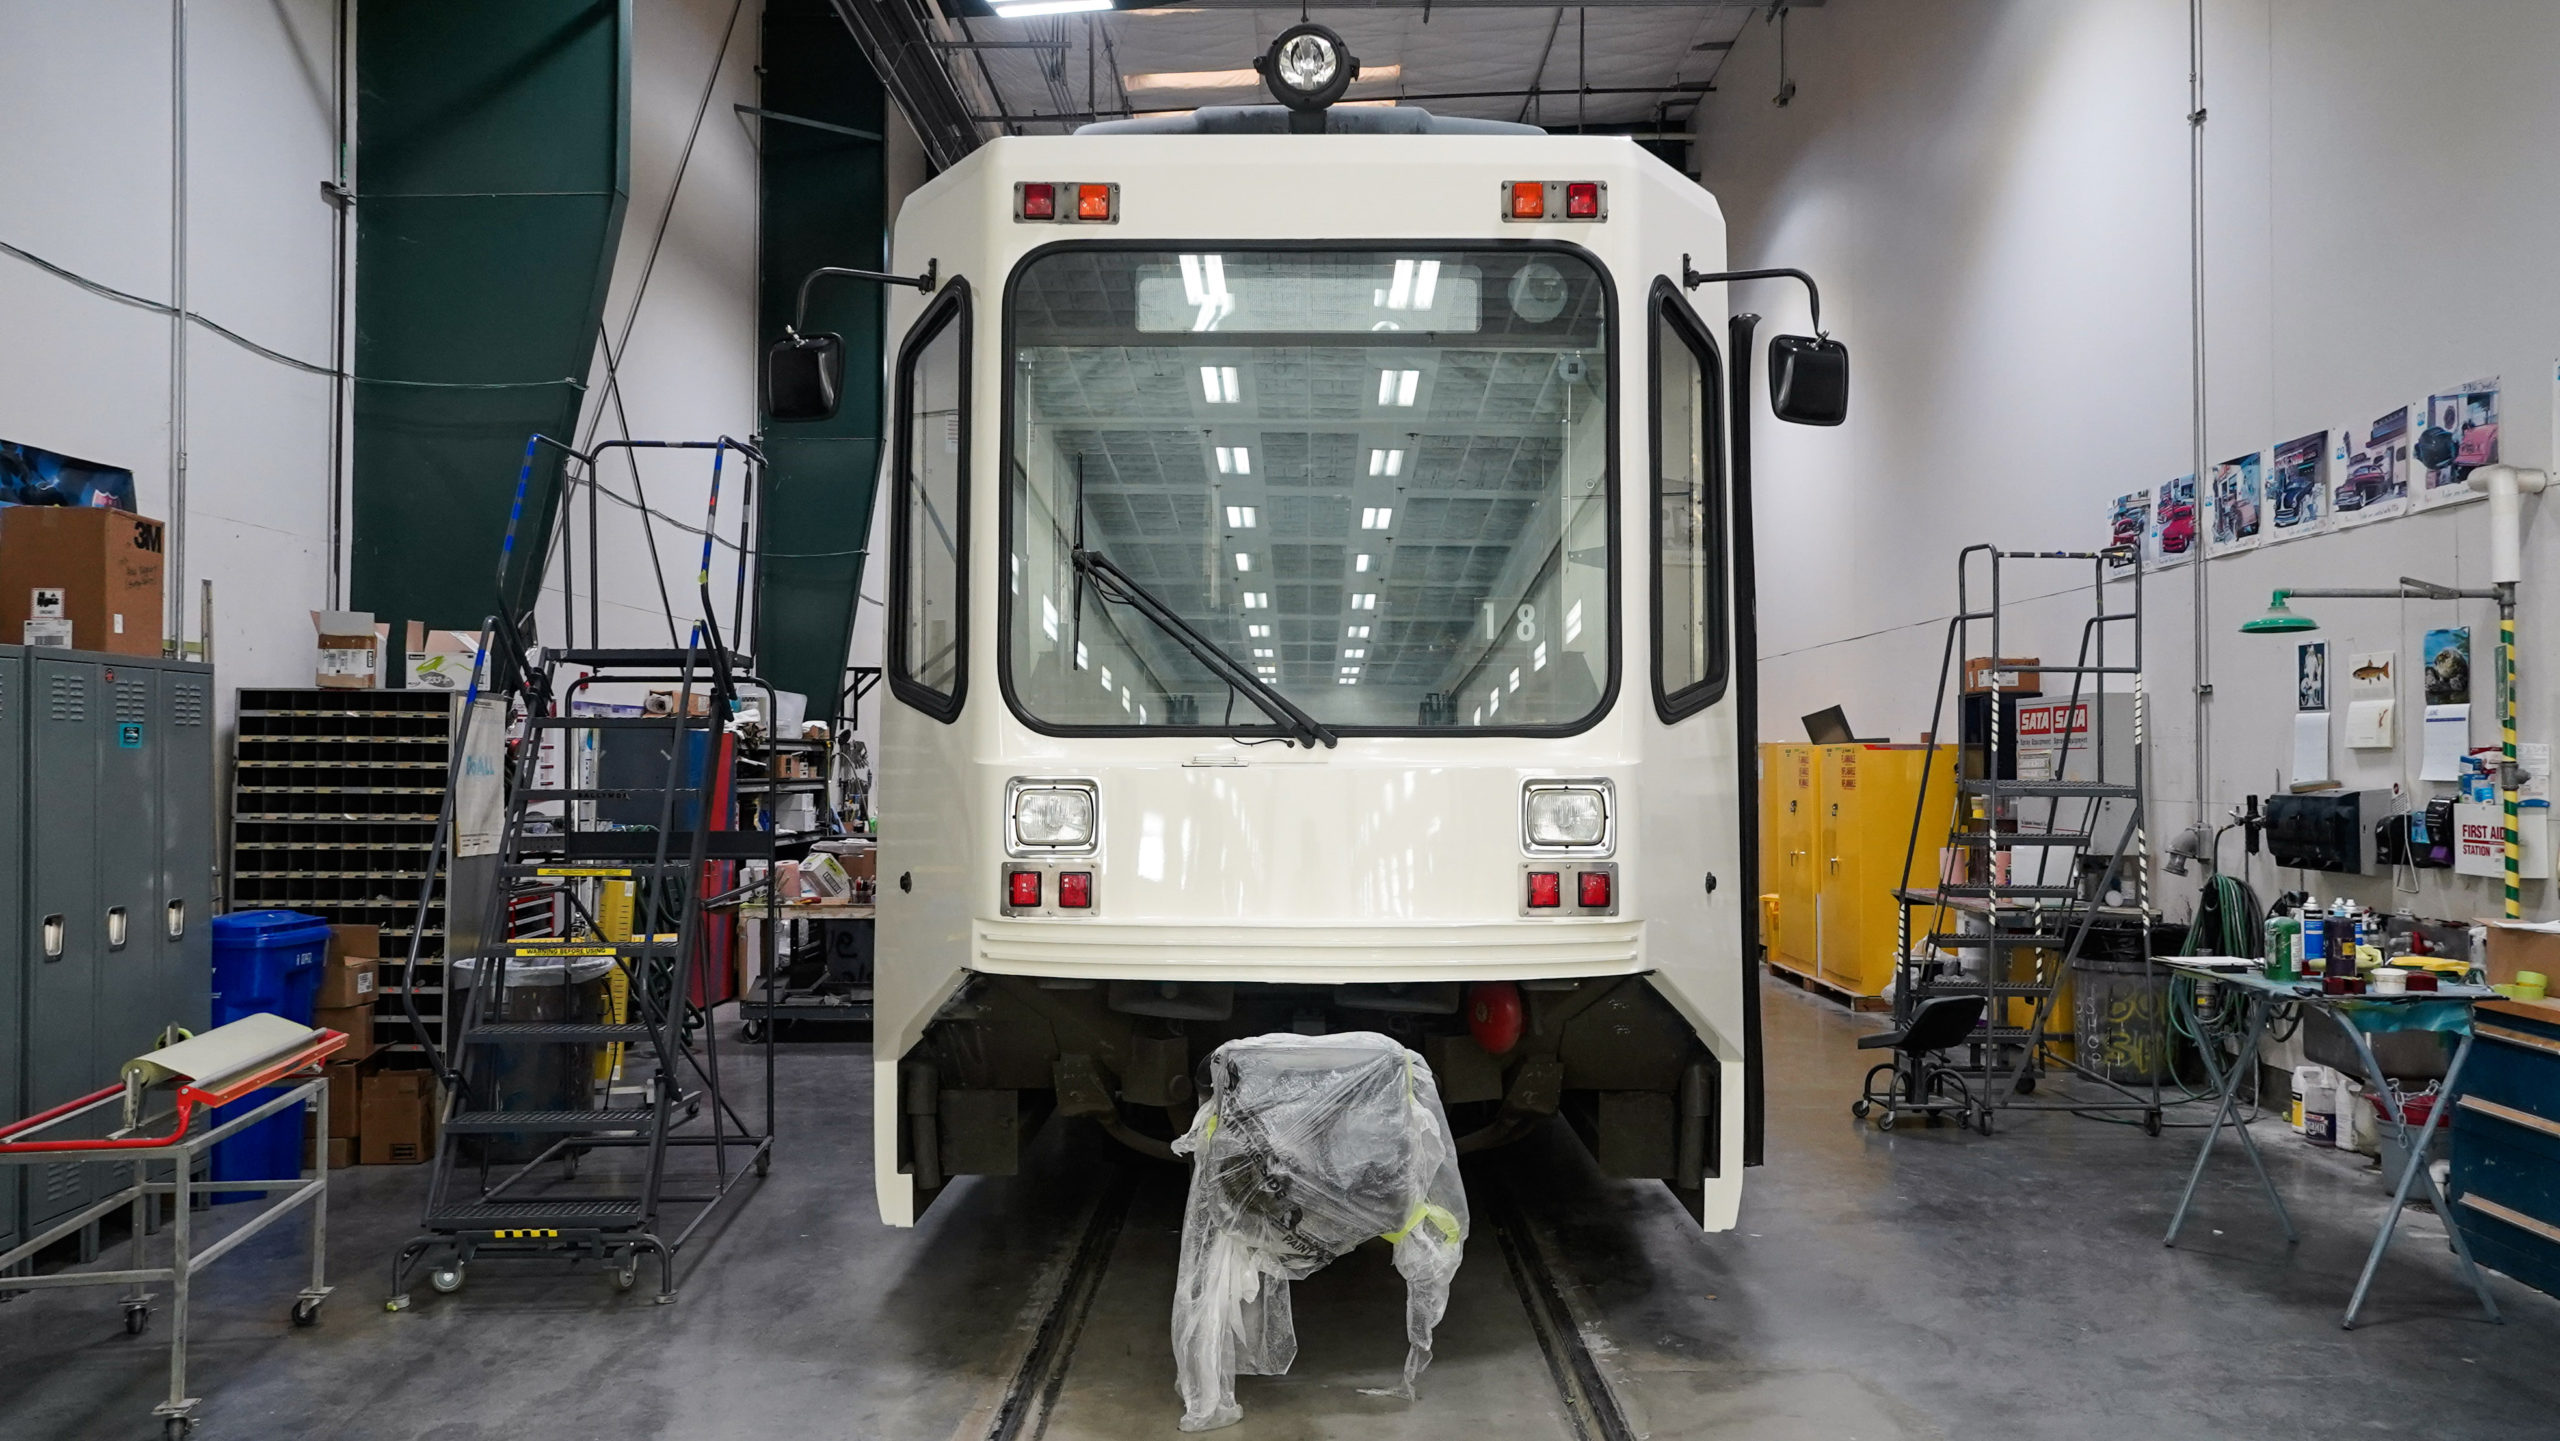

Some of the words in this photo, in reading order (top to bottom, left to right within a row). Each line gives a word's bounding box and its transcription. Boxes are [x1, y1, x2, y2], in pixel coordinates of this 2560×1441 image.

[134, 521, 162, 553] 3M
[2021, 712, 2049, 730] SATA
[2462, 824, 2487, 839] FIRST
[2490, 826, 2505, 841] AID
[2463, 844, 2490, 856] STATION
[1282, 1234, 1316, 1256] PAINT
